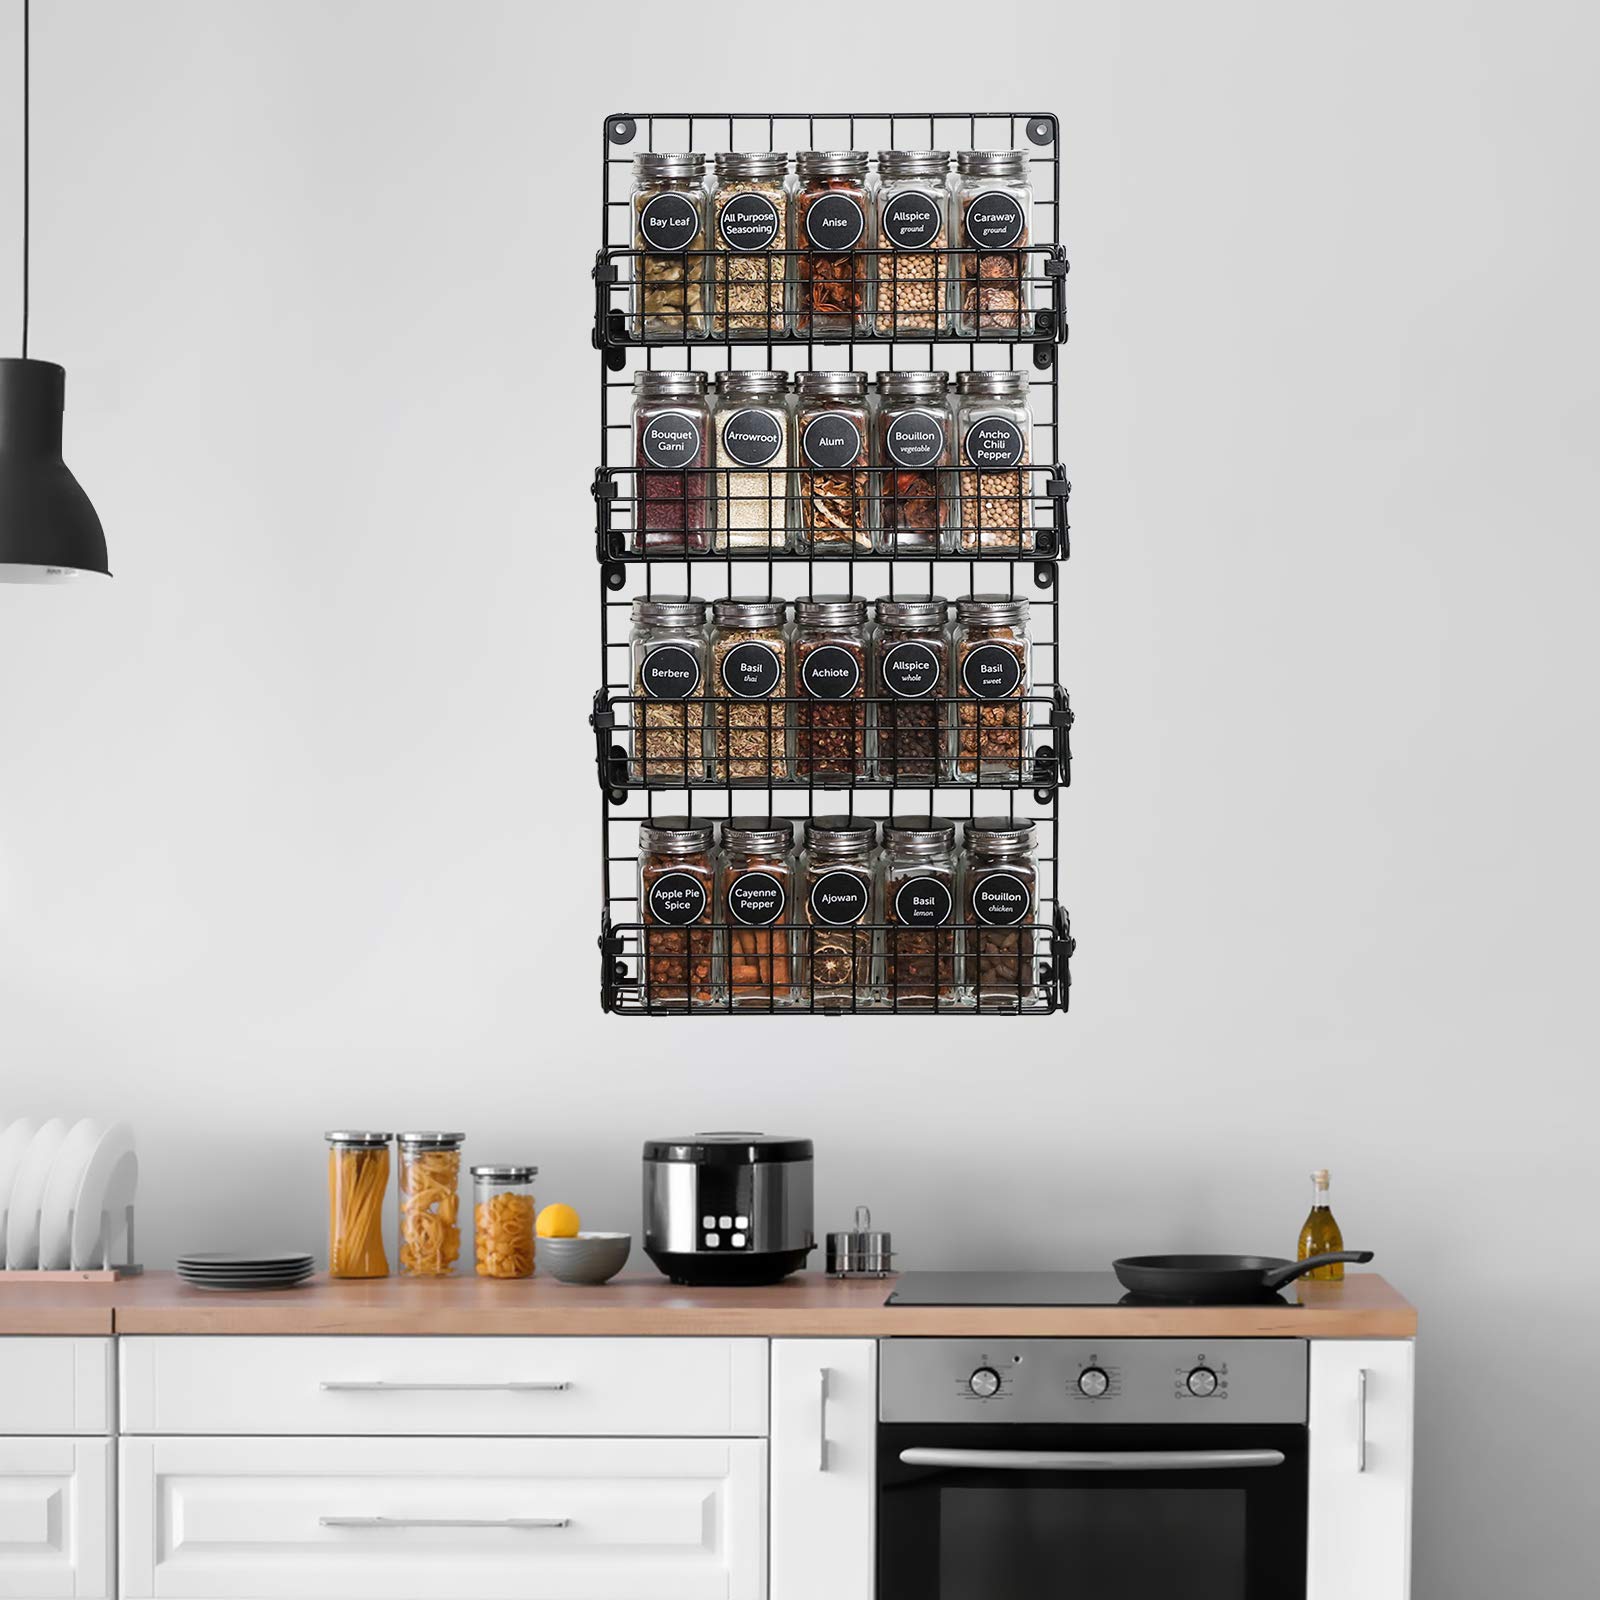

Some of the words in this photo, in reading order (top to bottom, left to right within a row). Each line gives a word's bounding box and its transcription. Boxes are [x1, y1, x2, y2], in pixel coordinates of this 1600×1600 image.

[724, 213, 735, 222] All
[737, 212, 774, 223] Purpose
[893, 211, 930, 222] Allspice
[974, 214, 1015, 223] Caraway
[650, 218, 667, 228] Bay
[669, 217, 690, 226] Leaf
[822, 218, 847, 226] Anise
[726, 224, 772, 235] Seasoning
[900, 225, 924, 234] ground
[983, 226, 1007, 235] ground
[652, 430, 692, 441] Bouquet
[728, 431, 777, 443] Arrowroot
[896, 432, 935, 440] Bouillon
[979, 430, 1010, 439] Ancho
[658, 442, 684, 451] Garni
[819, 438, 844, 446] Alum
[984, 440, 1005, 448] Chili
[900, 445, 930, 454] vegetable
[978, 450, 1011, 460] Pepper
[741, 663, 762, 672] Basil
[893, 661, 929, 671] Allspice
[981, 664, 1002, 673] Basil
[652, 669, 689, 678] Berbere
[812, 669, 849, 677] Achiote
[655, 890, 682, 900] Apple
[685, 889, 699, 897] Pie
[735, 889, 776, 899] Cayenne
[982, 892, 1021, 901] Bouillon
[822, 894, 857, 904] Ajowan
[913, 897, 934, 905] Basil
[665, 900, 690, 910] Spice
[741, 900, 774, 909] Pepper
